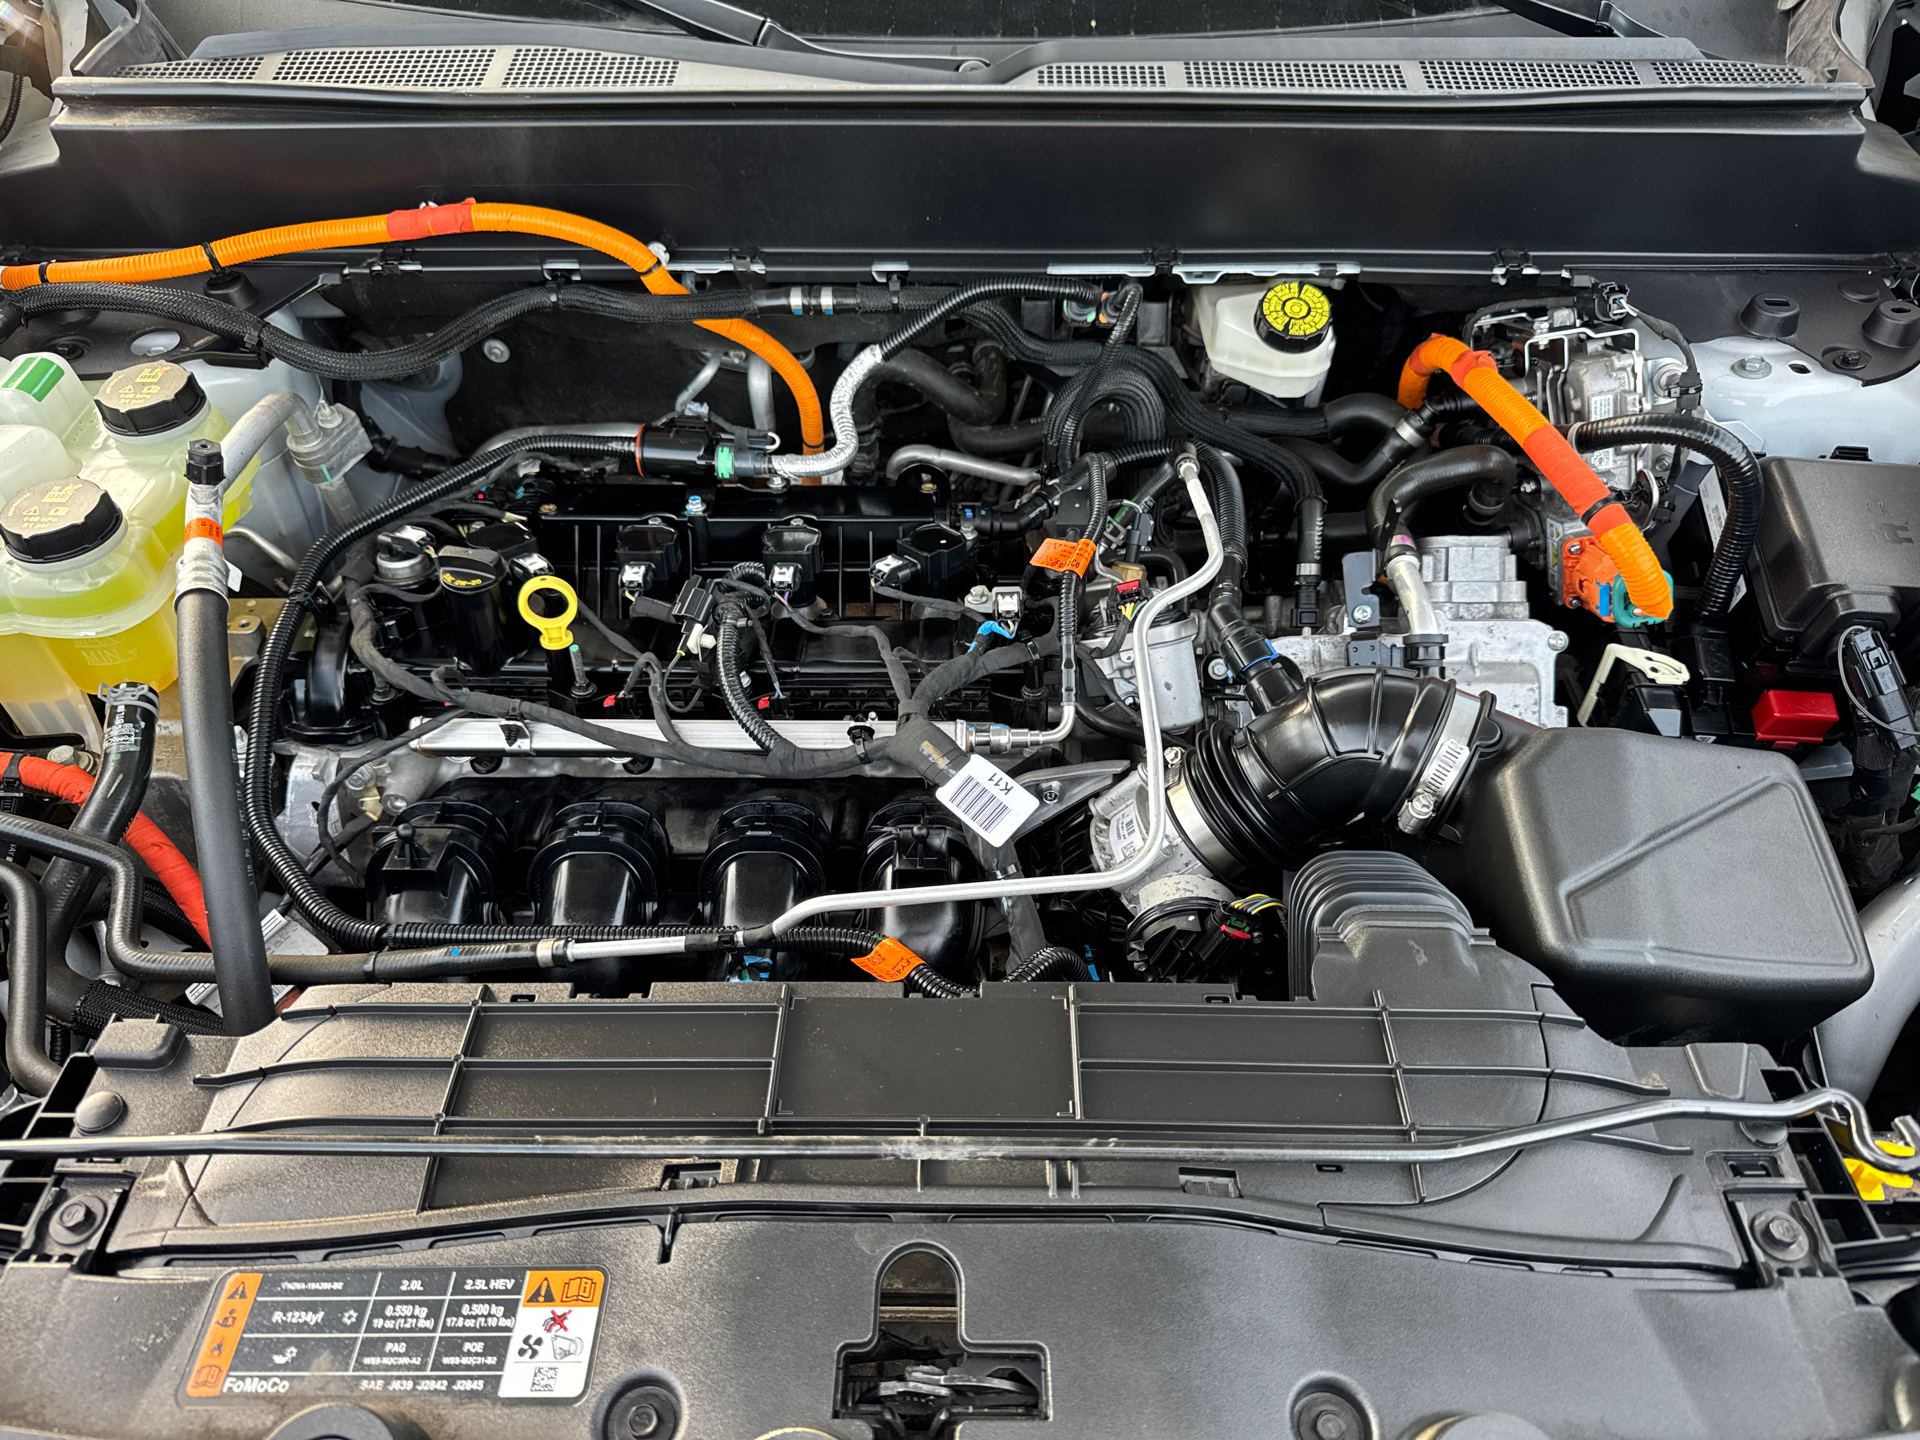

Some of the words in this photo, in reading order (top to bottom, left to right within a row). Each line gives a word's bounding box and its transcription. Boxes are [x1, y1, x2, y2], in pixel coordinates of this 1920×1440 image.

[987, 772, 1014, 796] K11
[400, 1279, 424, 1291] 2.0L
[464, 1279, 488, 1290] 2.5L
[489, 1279, 515, 1290] HEV
[385, 1305, 413, 1316] 0.550
[414, 1305, 429, 1318] kg
[461, 1304, 489, 1315] 0.500
[490, 1304, 504, 1317] kg
[272, 1311, 325, 1326] R-1234yf
[372, 1318, 385, 1328] 19
[386, 1320, 395, 1328] oz
[465, 1320, 475, 1328] oz
[385, 1342, 407, 1353] PAG
[462, 1342, 484, 1353] POE
[222, 1377, 290, 1393] FoMoCo
[359, 1380, 384, 1390] SAE
[387, 1379, 413, 1390] J639
[416, 1379, 448, 1390] J2842
[452, 1379, 484, 1390] J2845
